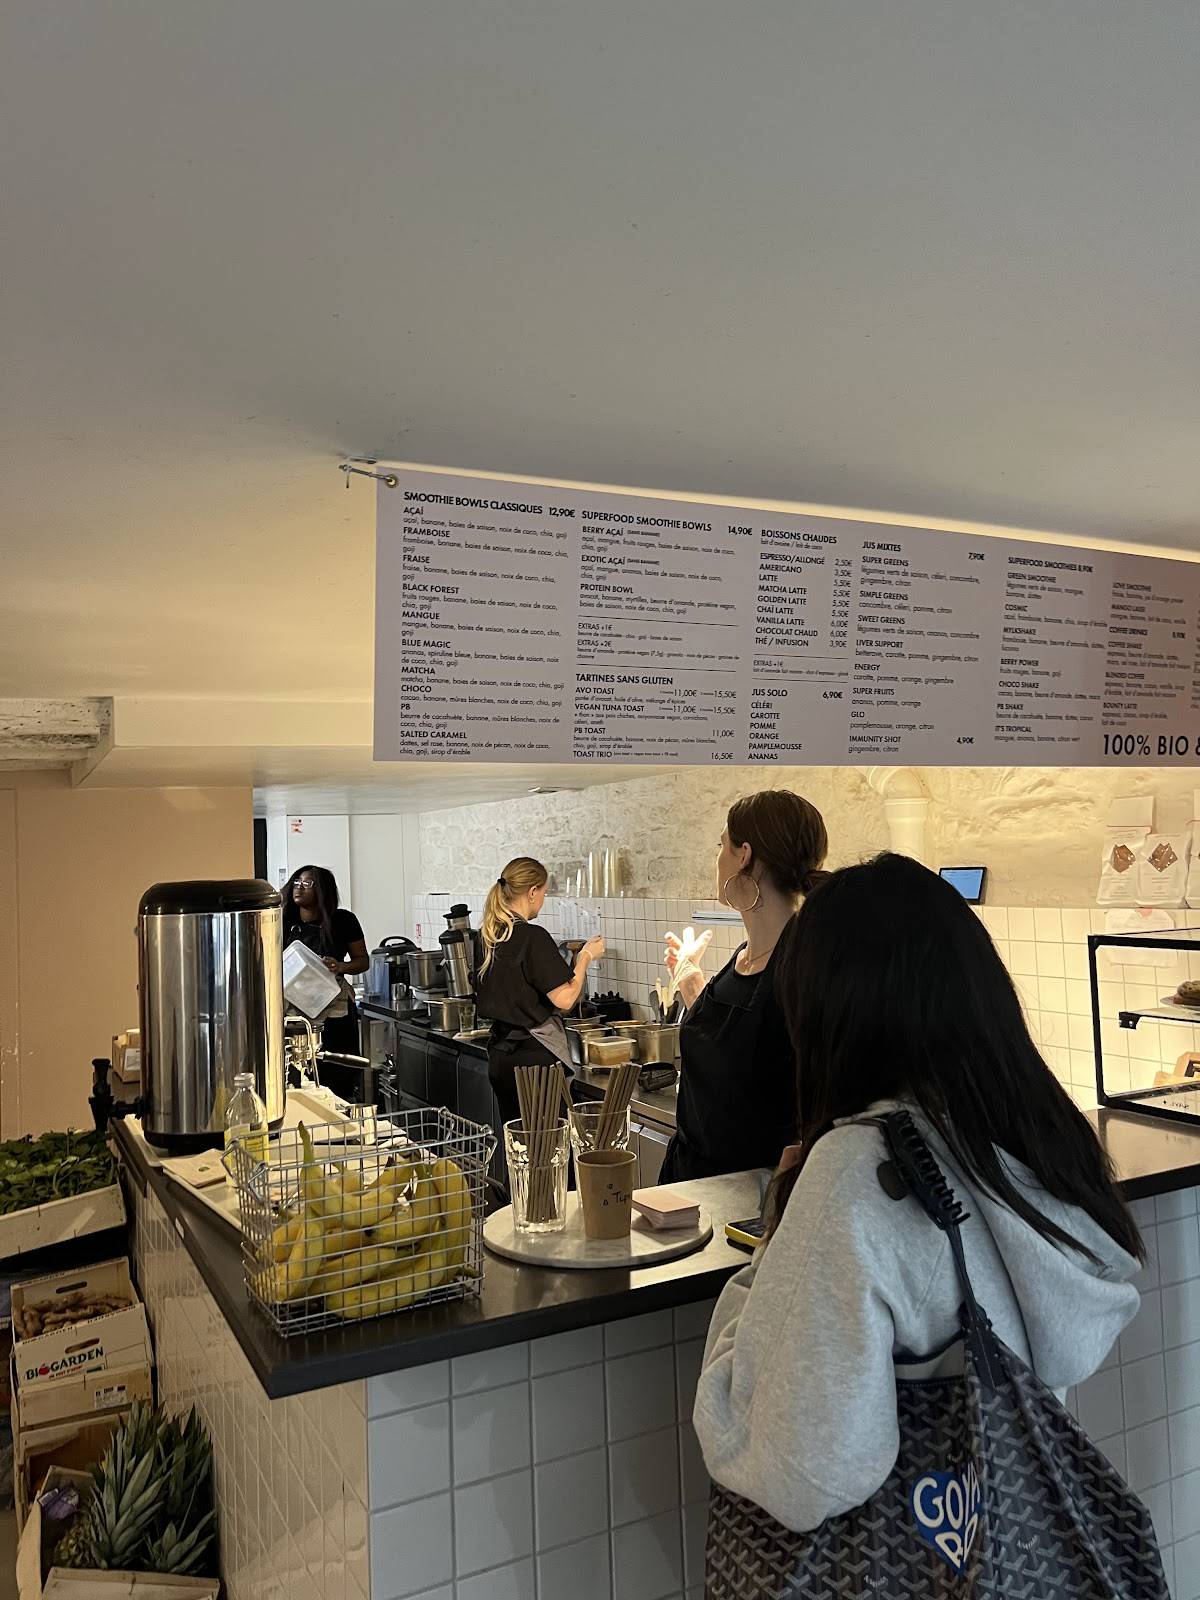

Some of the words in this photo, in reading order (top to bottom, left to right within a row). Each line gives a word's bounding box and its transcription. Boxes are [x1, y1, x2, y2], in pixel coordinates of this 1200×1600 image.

[404, 492, 454, 505] SMOOTHIE
[456, 497, 489, 508] BOWLS
[490, 501, 543, 514] CLASSIQUES
[549, 507, 575, 518] 12,90€
[403, 507, 424, 516] AÇAÍ
[582, 511, 635, 523] SUPERFOOD
[636, 517, 681, 528] SMOOTHIE
[683, 521, 712, 531] BOWLS
[728, 526, 753, 536] 14,90€
[404, 527, 450, 538] FRAMBOISE
[762, 530, 801, 540] BOISSONS
[803, 534, 837, 544] CHAUDES
[862, 541, 876, 550] JUS
[877, 543, 902, 552] MIXTES
[403, 555, 430, 564] FRAISE
[835, 559, 853, 567] 2,50€
[862, 556, 882, 564] SUPER
[883, 558, 909, 567] GREENS
[760, 564, 802, 573] AMERICANO
[834, 569, 852, 578] 3,50€
[403, 583, 429, 592] BLACK
[431, 585, 460, 594] FOREST
[581, 584, 611, 592] PROTEIN
[834, 579, 851, 588] 5,50€
[758, 595, 787, 603] GOLDEN
[833, 590, 851, 598] 5,50€
[860, 590, 882, 599] SIMPLE
[883, 593, 909, 601] GREENS
[402, 611, 440, 620] MANGUE
[757, 605, 774, 613] CHAÏ
[832, 610, 850, 618] 5,50€
[756, 627, 794, 635] CHOCOLAT
[402, 639, 421, 647] BLUE
[423, 640, 451, 648] MAGIC
[755, 637, 767, 645] THÉ
[776, 639, 809, 647] INFUSION
[576, 674, 615, 682] TARTINES
[617, 675, 640, 684] SANS
[642, 677, 673, 685] GLUTEN
[401, 685, 432, 693] CHOCO
[674, 689, 698, 697] 11,00€
[714, 691, 737, 699] 15,50€
[674, 705, 696, 714] 11,00€
[714, 707, 736, 715] 15,50€
[751, 701, 773, 709] CÉLÉRI
[1104, 734, 1151, 755] 100%
[1158, 736, 1189, 756] BIO
